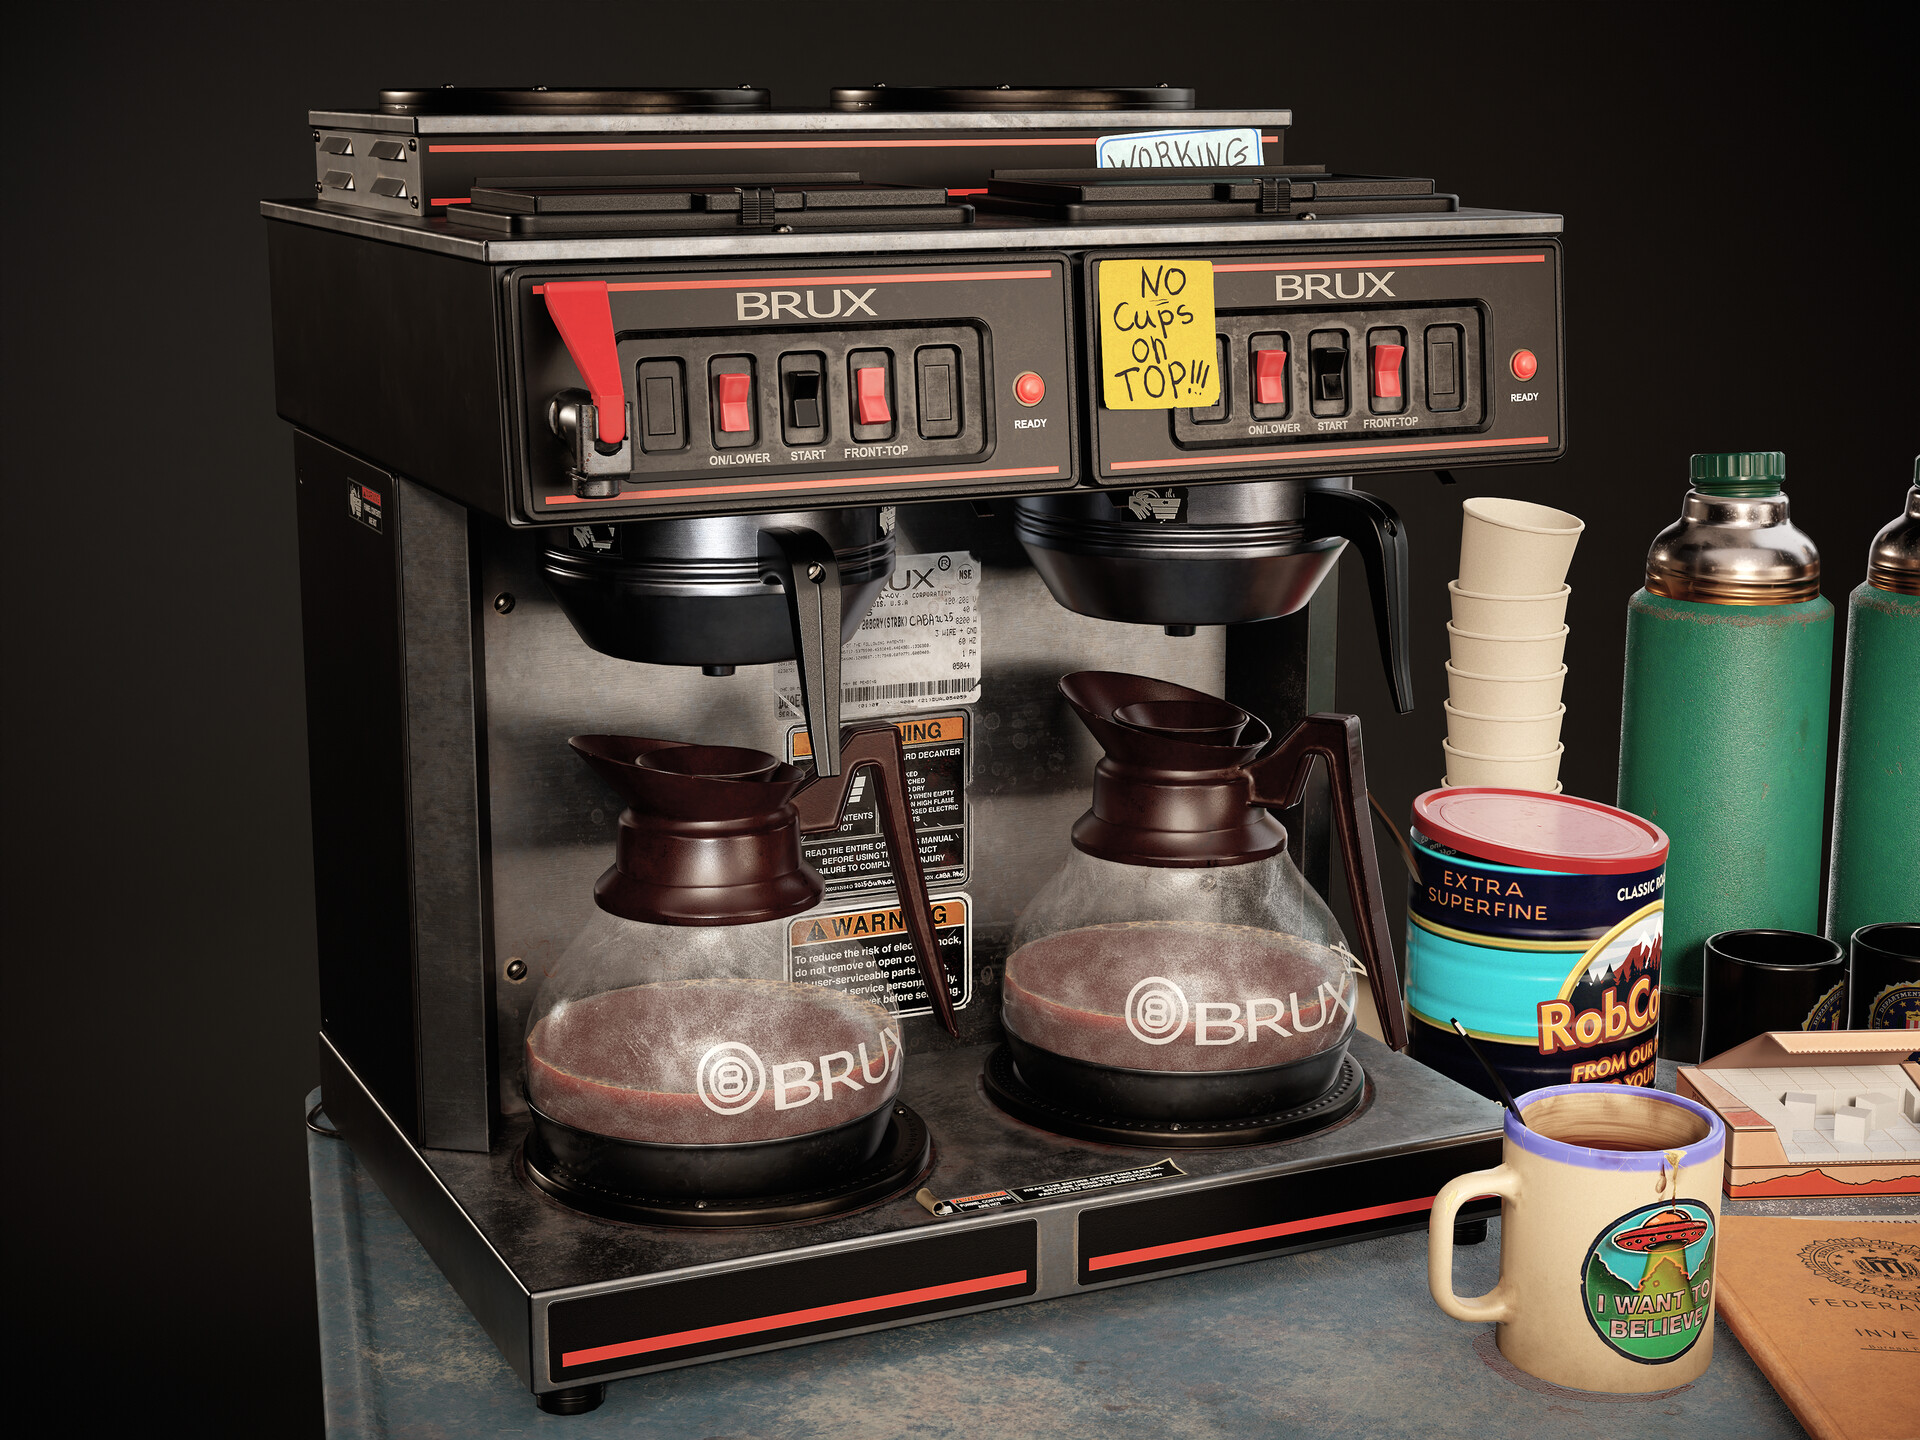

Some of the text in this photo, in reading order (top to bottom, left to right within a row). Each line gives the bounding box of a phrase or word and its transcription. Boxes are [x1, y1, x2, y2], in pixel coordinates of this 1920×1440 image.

[1107, 137, 1249, 167] WORKING
[1141, 265, 1187, 298] NO
[1274, 271, 1396, 302] BRUX
[735, 288, 878, 322] BRUX
[1113, 301, 1194, 339] Cups
[1132, 335, 1168, 364] on
[1114, 359, 1210, 402] TOP!!!
[1510, 392, 1539, 403] READY
[1014, 418, 1047, 429] READY
[1248, 416, 1419, 435] ON/LOWER START FRONT-TOP
[709, 445, 909, 466] ON/LOWER START FRONT-TOP
[918, 747, 961, 759] DECANTER
[916, 798, 933, 807] HIGH
[928, 803, 959, 813] ELECTRIC
[805, 848, 828, 858] READ
[828, 846, 844, 855] THE
[845, 842, 874, 853] ENTIRE
[921, 834, 954, 845] MANUAL
[822, 854, 854, 866] BEFORE
[855, 851, 880, 862] USING
[848, 864, 859, 872] TO
[860, 860, 891, 871] COMPLY
[1444, 870, 1524, 898] EXTRA
[1616, 879, 1655, 902] CLASSIC
[1428, 887, 1548, 921] SUPERFINE
[794, 955, 807, 965] To
[809, 951, 843, 963] reduce
[843, 948, 860, 958] the
[861, 945, 880, 956] risk
[881, 943, 892, 954] of
[795, 968, 808, 978] do
[810, 965, 826, 976] not
[828, 961, 864, 973] remove
[865, 960, 876, 968] or
[878, 956, 902, 968] open
[891, 966, 916, 979] parts
[850, 983, 884, 996] service
[883, 992, 914, 1004] before
[1194, 972, 1350, 1046] BRUX
[1572, 1053, 1626, 1083] FROM
[1629, 1041, 1654, 1067] OUR
[1596, 1278, 1711, 1315] I WANT TO
[1609, 1305, 1704, 1338] BELIEVE
